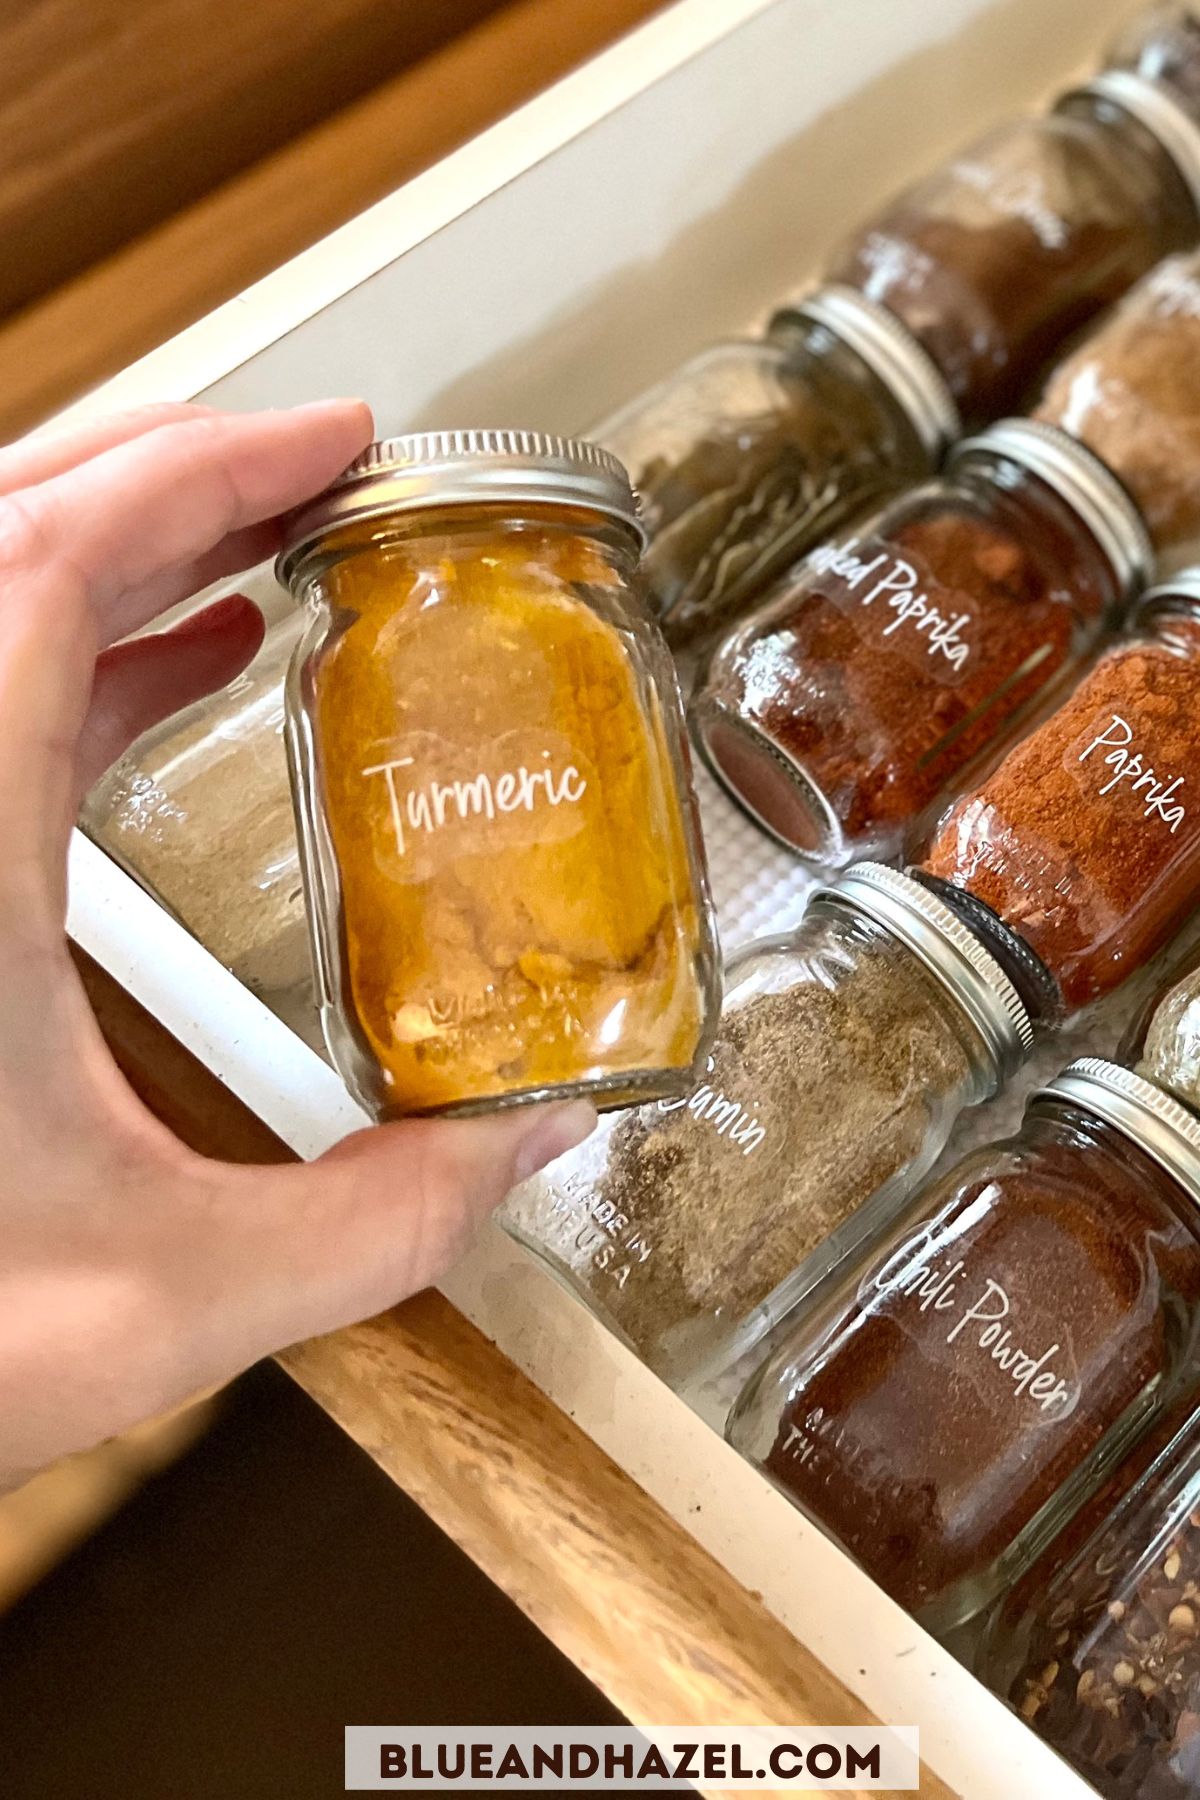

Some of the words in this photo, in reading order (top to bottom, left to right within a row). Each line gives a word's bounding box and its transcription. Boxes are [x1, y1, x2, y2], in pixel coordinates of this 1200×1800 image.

[863, 559, 971, 672] Paprika
[361, 749, 587, 855] Turmeric
[1079, 714, 1185, 833] Paprika
[562, 1172, 629, 1239] MADE
[625, 1231, 653, 1263] IN
[947, 1278, 1070, 1411] Powder
